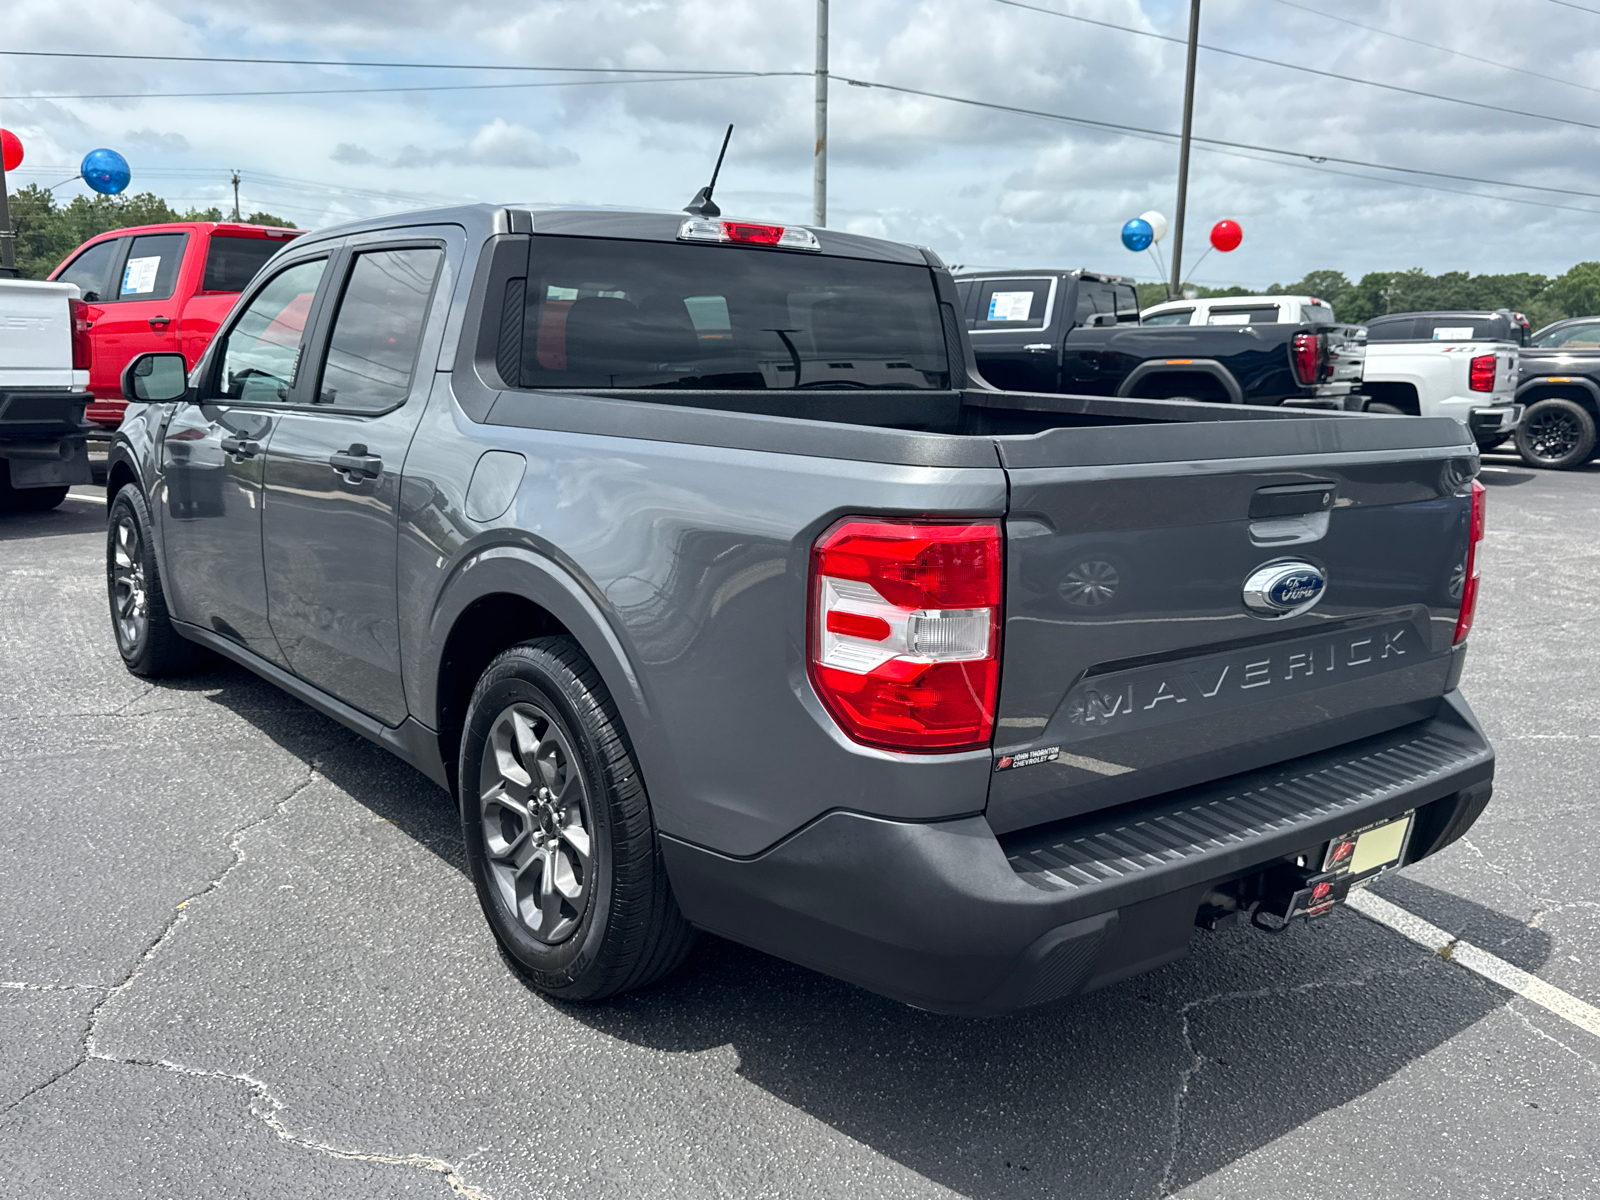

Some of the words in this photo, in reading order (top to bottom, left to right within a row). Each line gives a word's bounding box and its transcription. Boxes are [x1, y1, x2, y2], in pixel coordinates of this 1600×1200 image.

[1281, 576, 1317, 602] Ford
[1084, 629, 1407, 722] MAVERICK
[1013, 755, 1047, 768] CHEVROLET
[1014, 753, 1029, 761] JOHN
[1030, 746, 1059, 757] THORNTON
